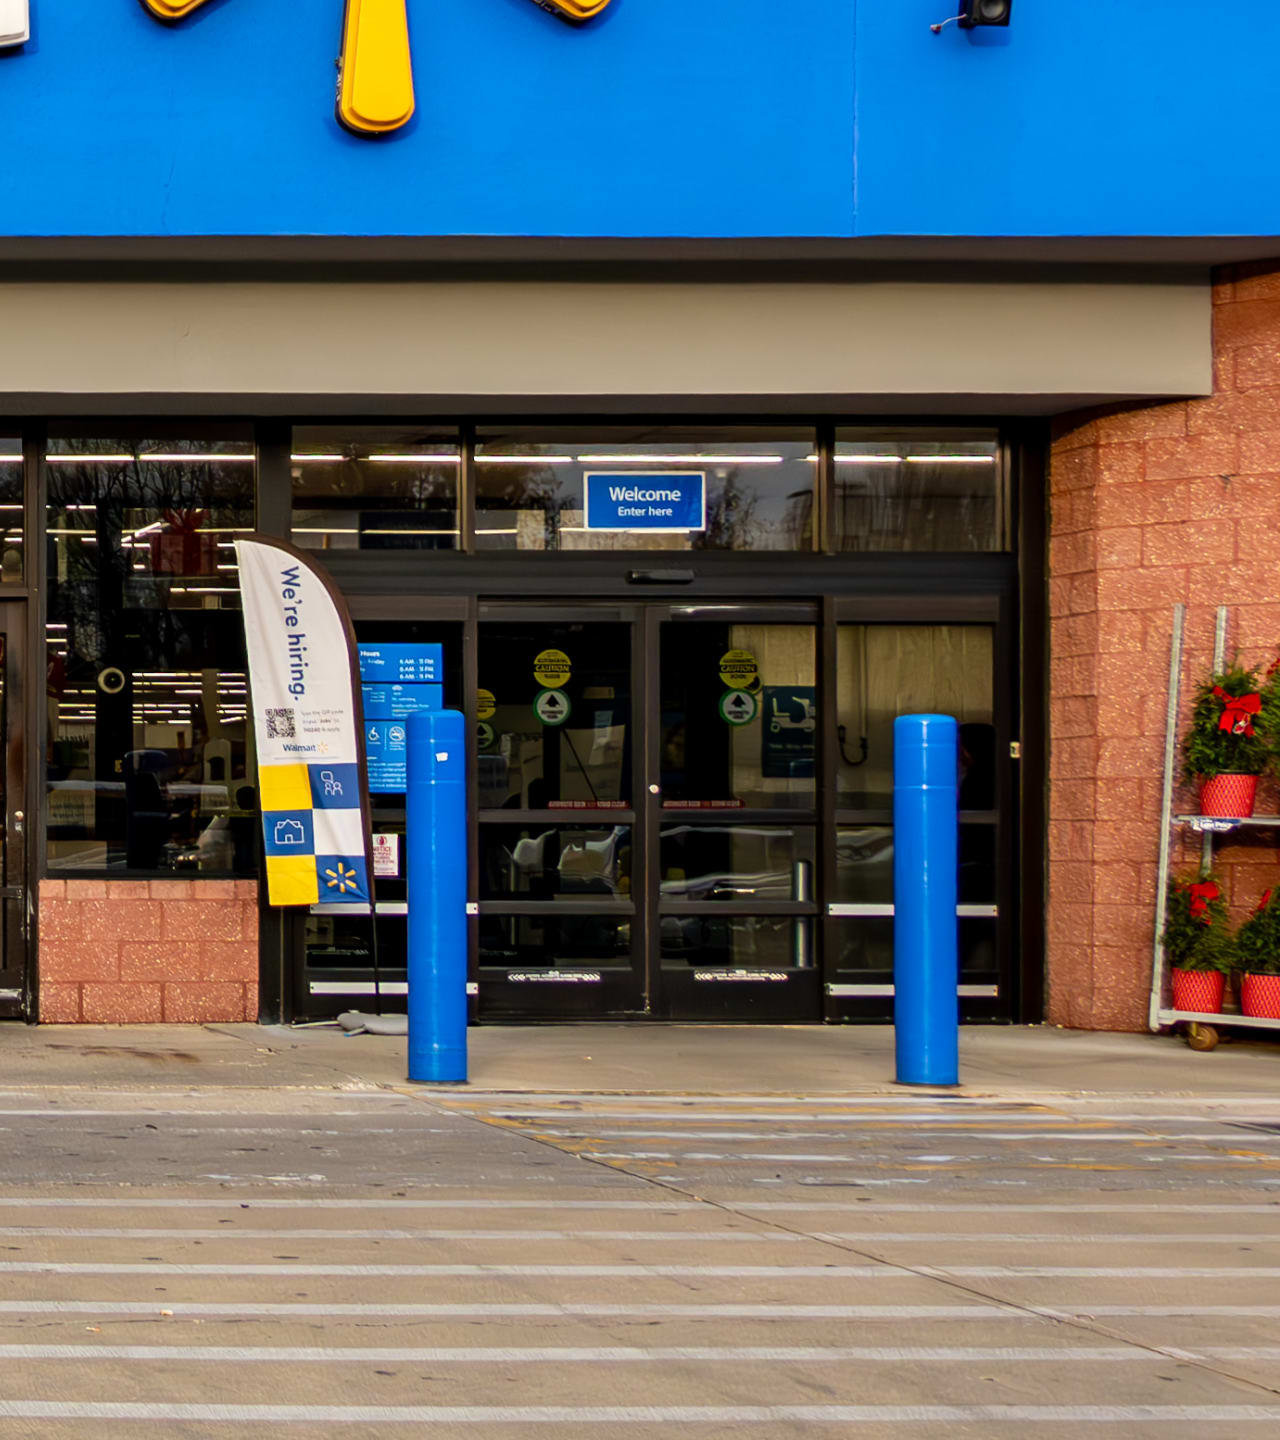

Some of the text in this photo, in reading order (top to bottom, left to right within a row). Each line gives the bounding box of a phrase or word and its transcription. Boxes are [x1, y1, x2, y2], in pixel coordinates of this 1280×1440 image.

[609, 486, 682, 502] Welcome
[618, 506, 673, 517] Enter here
[280, 566, 309, 701] We're hiring.
[282, 743, 317, 752] Walmart
